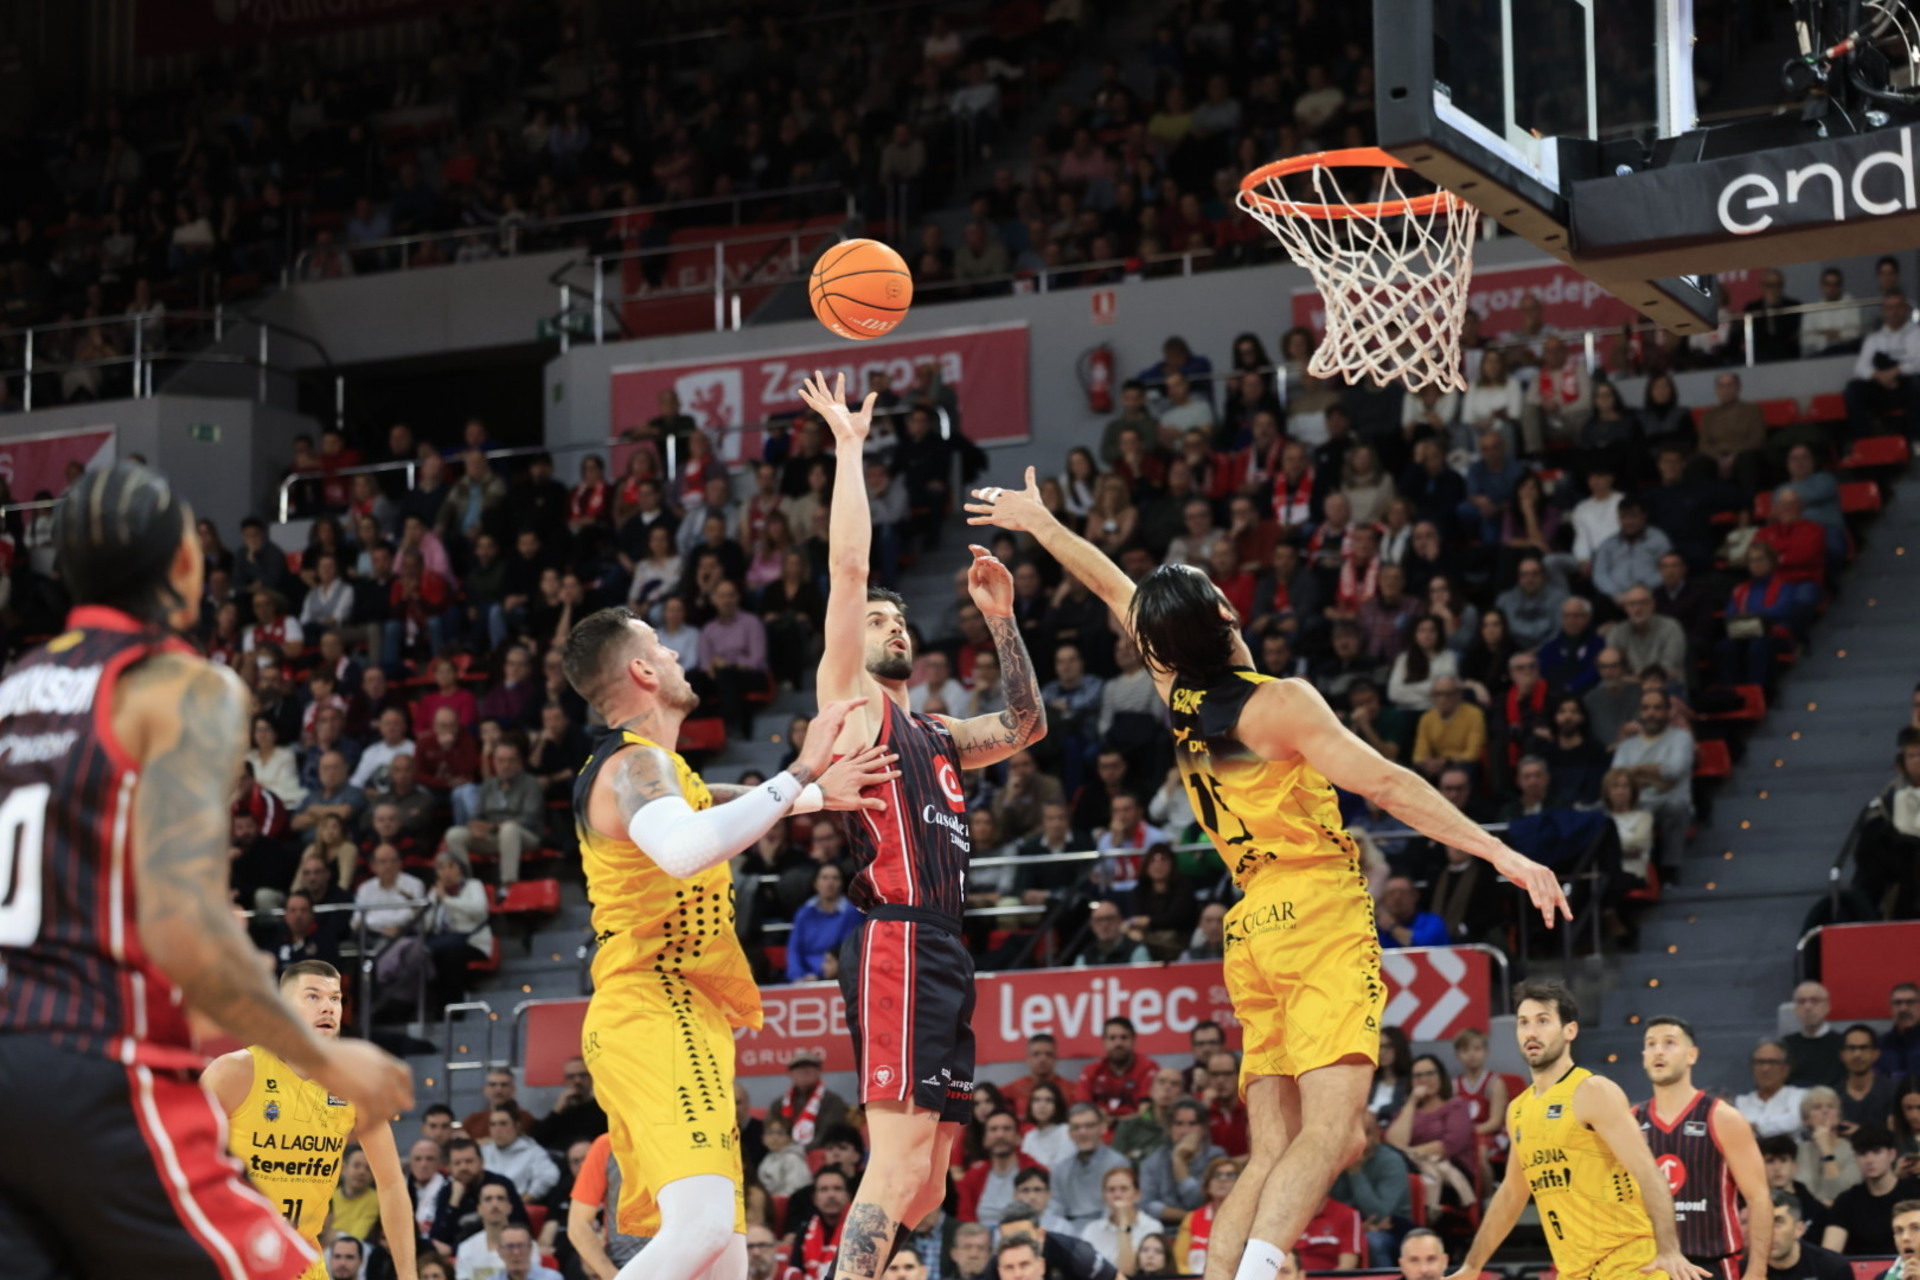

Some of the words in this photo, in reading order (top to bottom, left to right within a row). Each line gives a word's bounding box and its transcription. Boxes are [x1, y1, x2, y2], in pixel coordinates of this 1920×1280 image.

[1717, 126, 1917, 235] end
[1000, 977, 1198, 1042] levitec
[252, 1132, 276, 1149] LA
[281, 1134, 343, 1153] LAGUNA
[1547, 1210, 1565, 1241] 6
